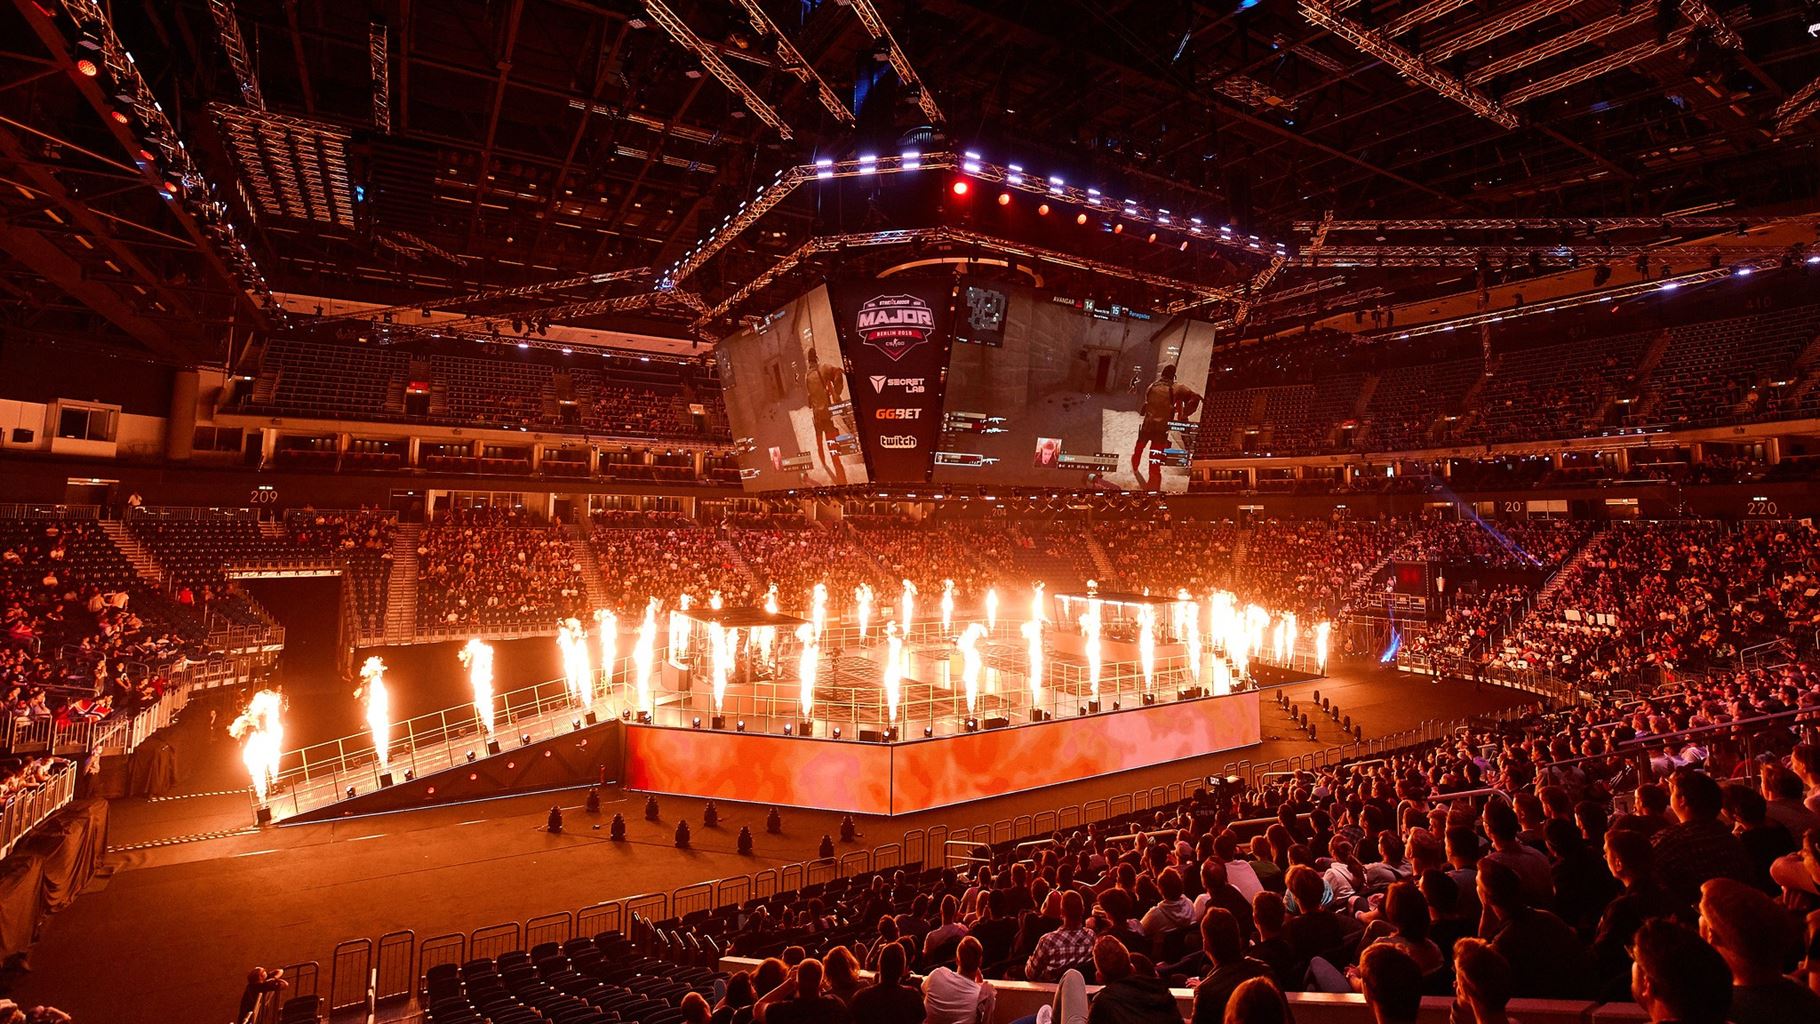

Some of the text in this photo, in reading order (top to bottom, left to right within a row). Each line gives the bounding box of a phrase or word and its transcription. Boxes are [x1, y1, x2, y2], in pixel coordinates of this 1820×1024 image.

[1085, 301, 1093, 310] 14
[1112, 306, 1120, 315] 15
[859, 310, 932, 327] MAJOR
[887, 378, 925, 386] SECRET
[905, 385, 925, 393] LAB
[880, 435, 917, 449] twitch
[250, 490, 278, 504] 209
[1505, 501, 1524, 512] 20
[1747, 501, 1777, 515] 220
